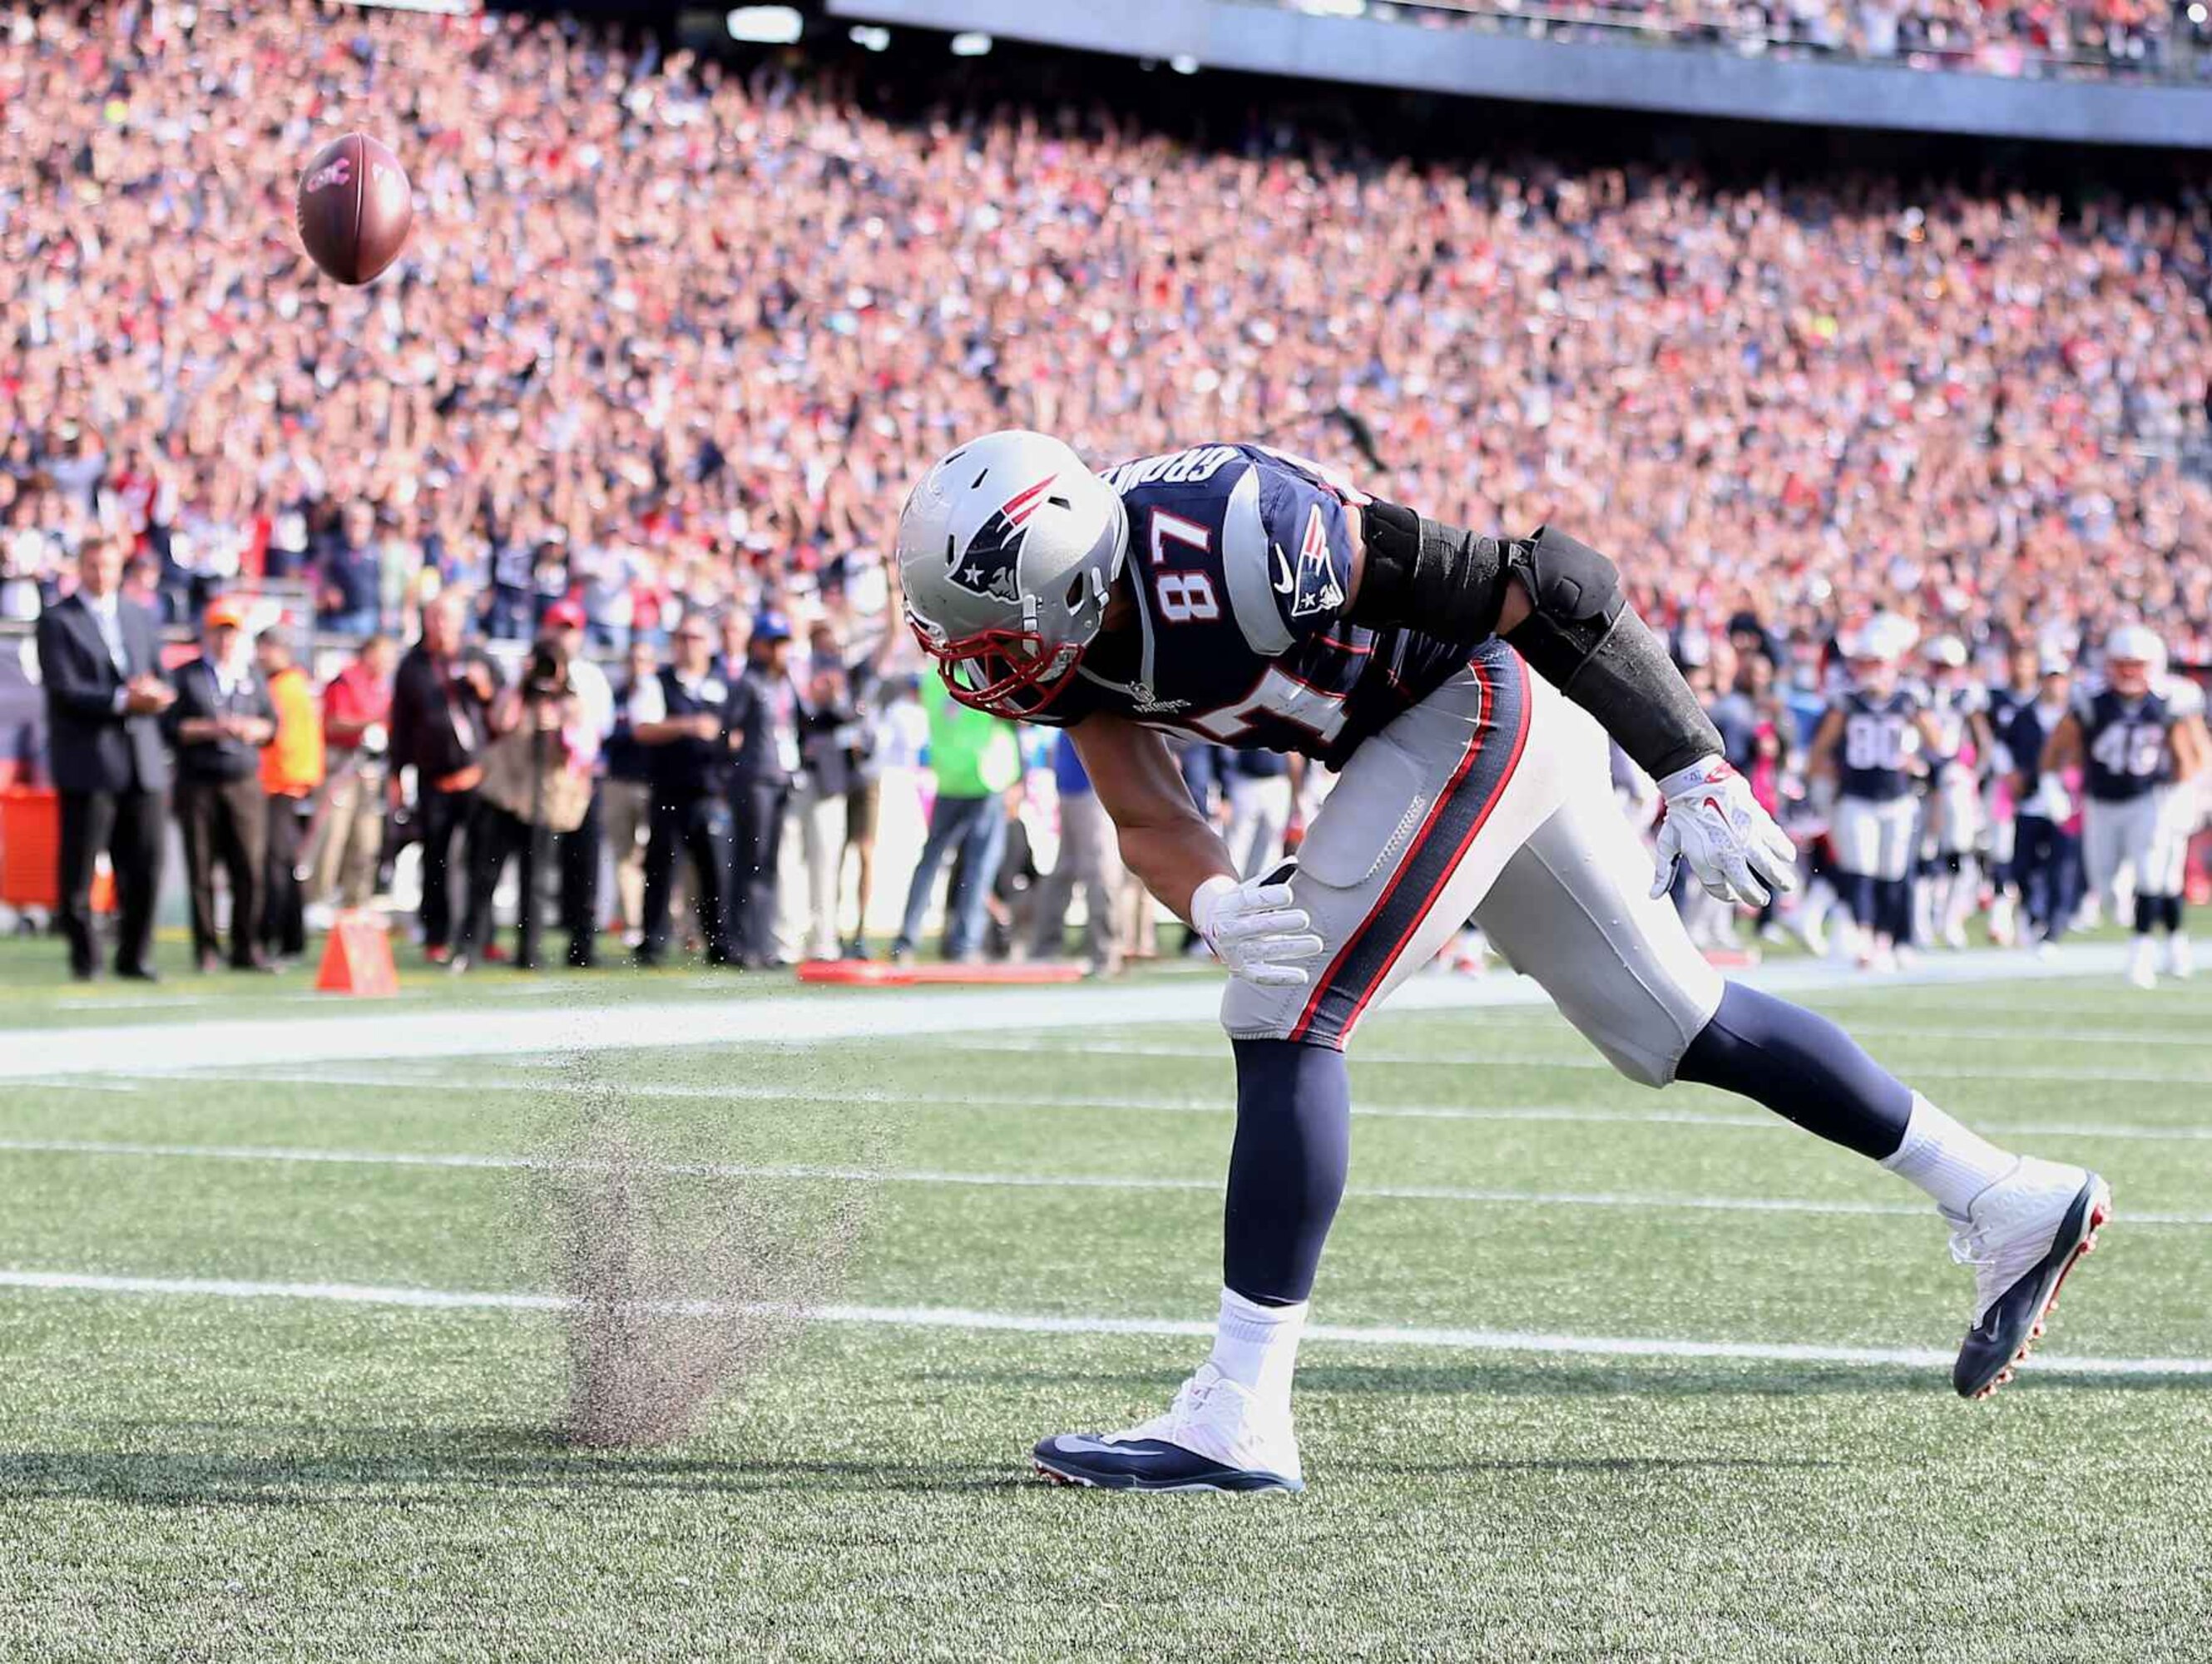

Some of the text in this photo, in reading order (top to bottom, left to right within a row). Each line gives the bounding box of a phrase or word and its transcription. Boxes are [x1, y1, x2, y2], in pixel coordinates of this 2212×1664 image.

[1096, 445, 1239, 496] GRON
[1150, 506, 1220, 622] 87
[1189, 663, 1353, 743] 7
